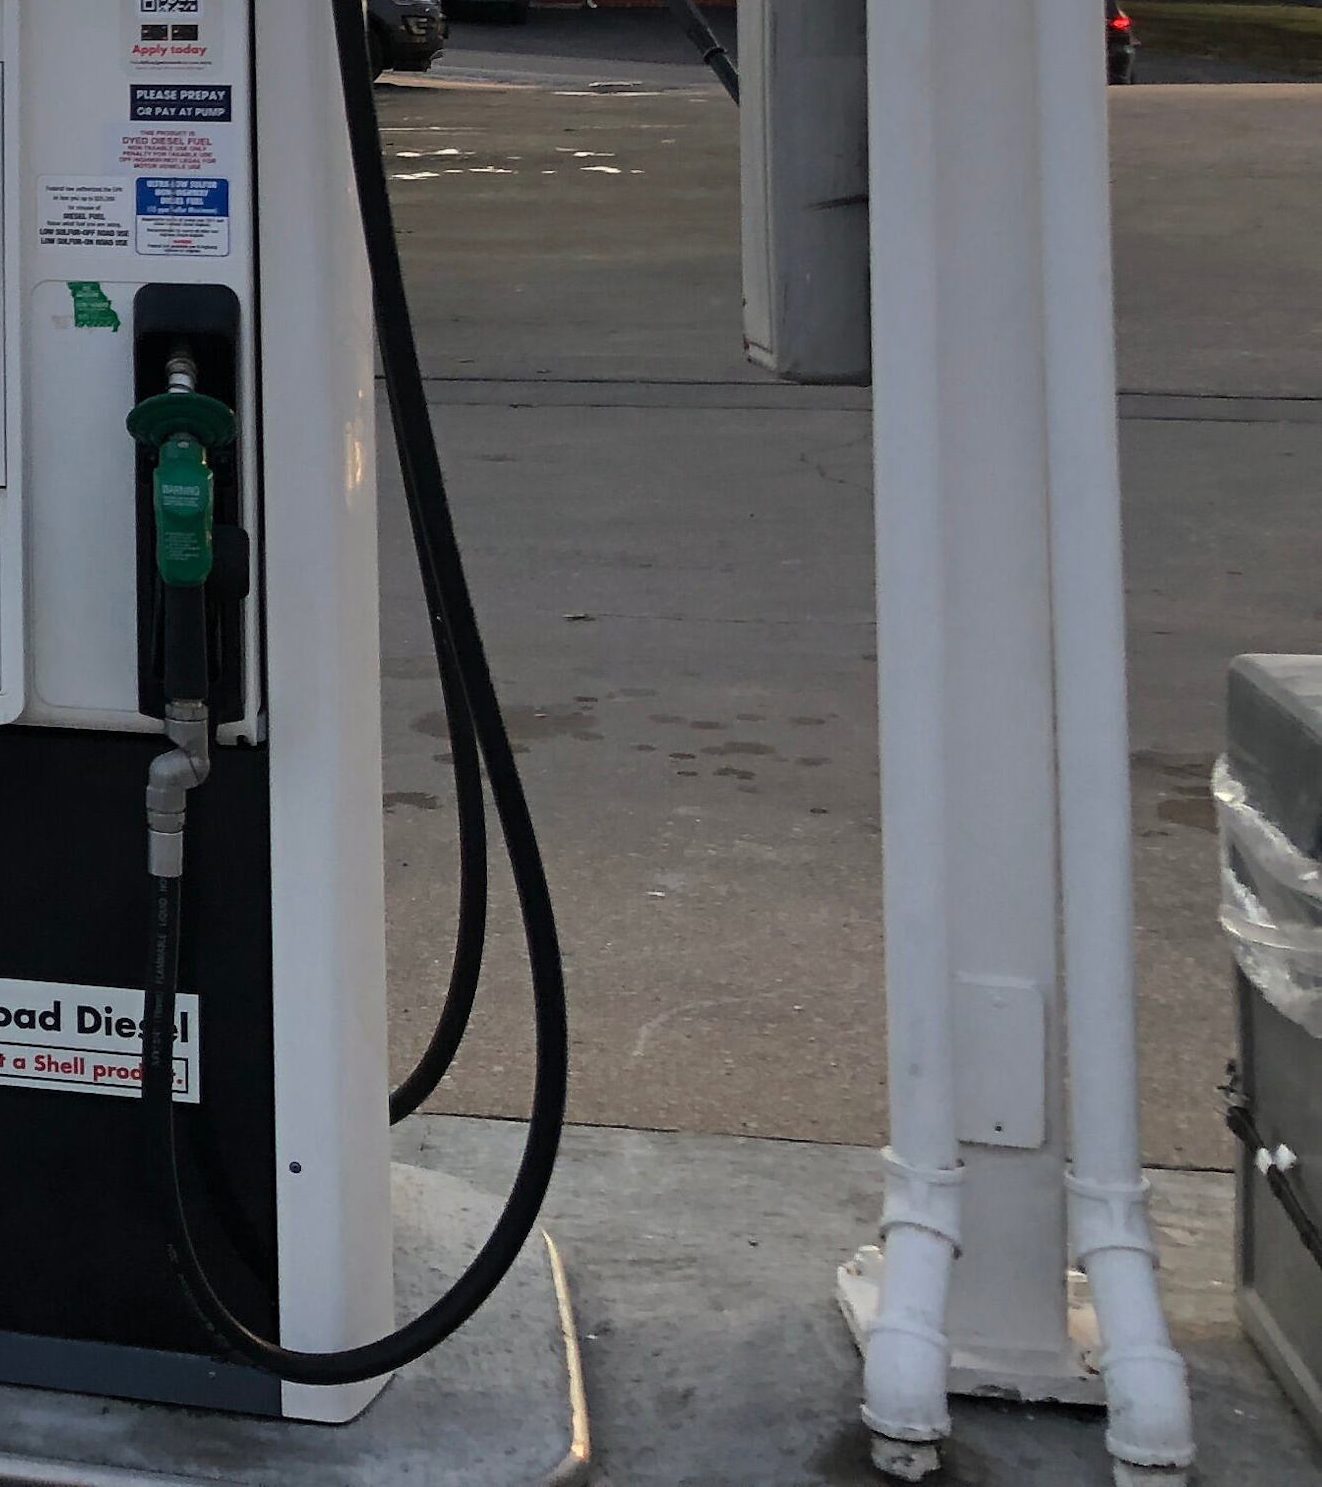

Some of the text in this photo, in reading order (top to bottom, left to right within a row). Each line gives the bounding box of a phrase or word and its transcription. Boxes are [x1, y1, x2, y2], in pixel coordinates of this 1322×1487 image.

[132, 44, 207, 56] Apply today
[136, 90, 226, 101] PLEASE PREPAY
[136, 107, 226, 117] OR PAY AT PUMP
[151, 137, 184, 145] DIESEL
[76, 1005, 189, 1043] Diel
[12, 1056, 26, 1070] a
[34, 1053, 85, 1076] Shell
